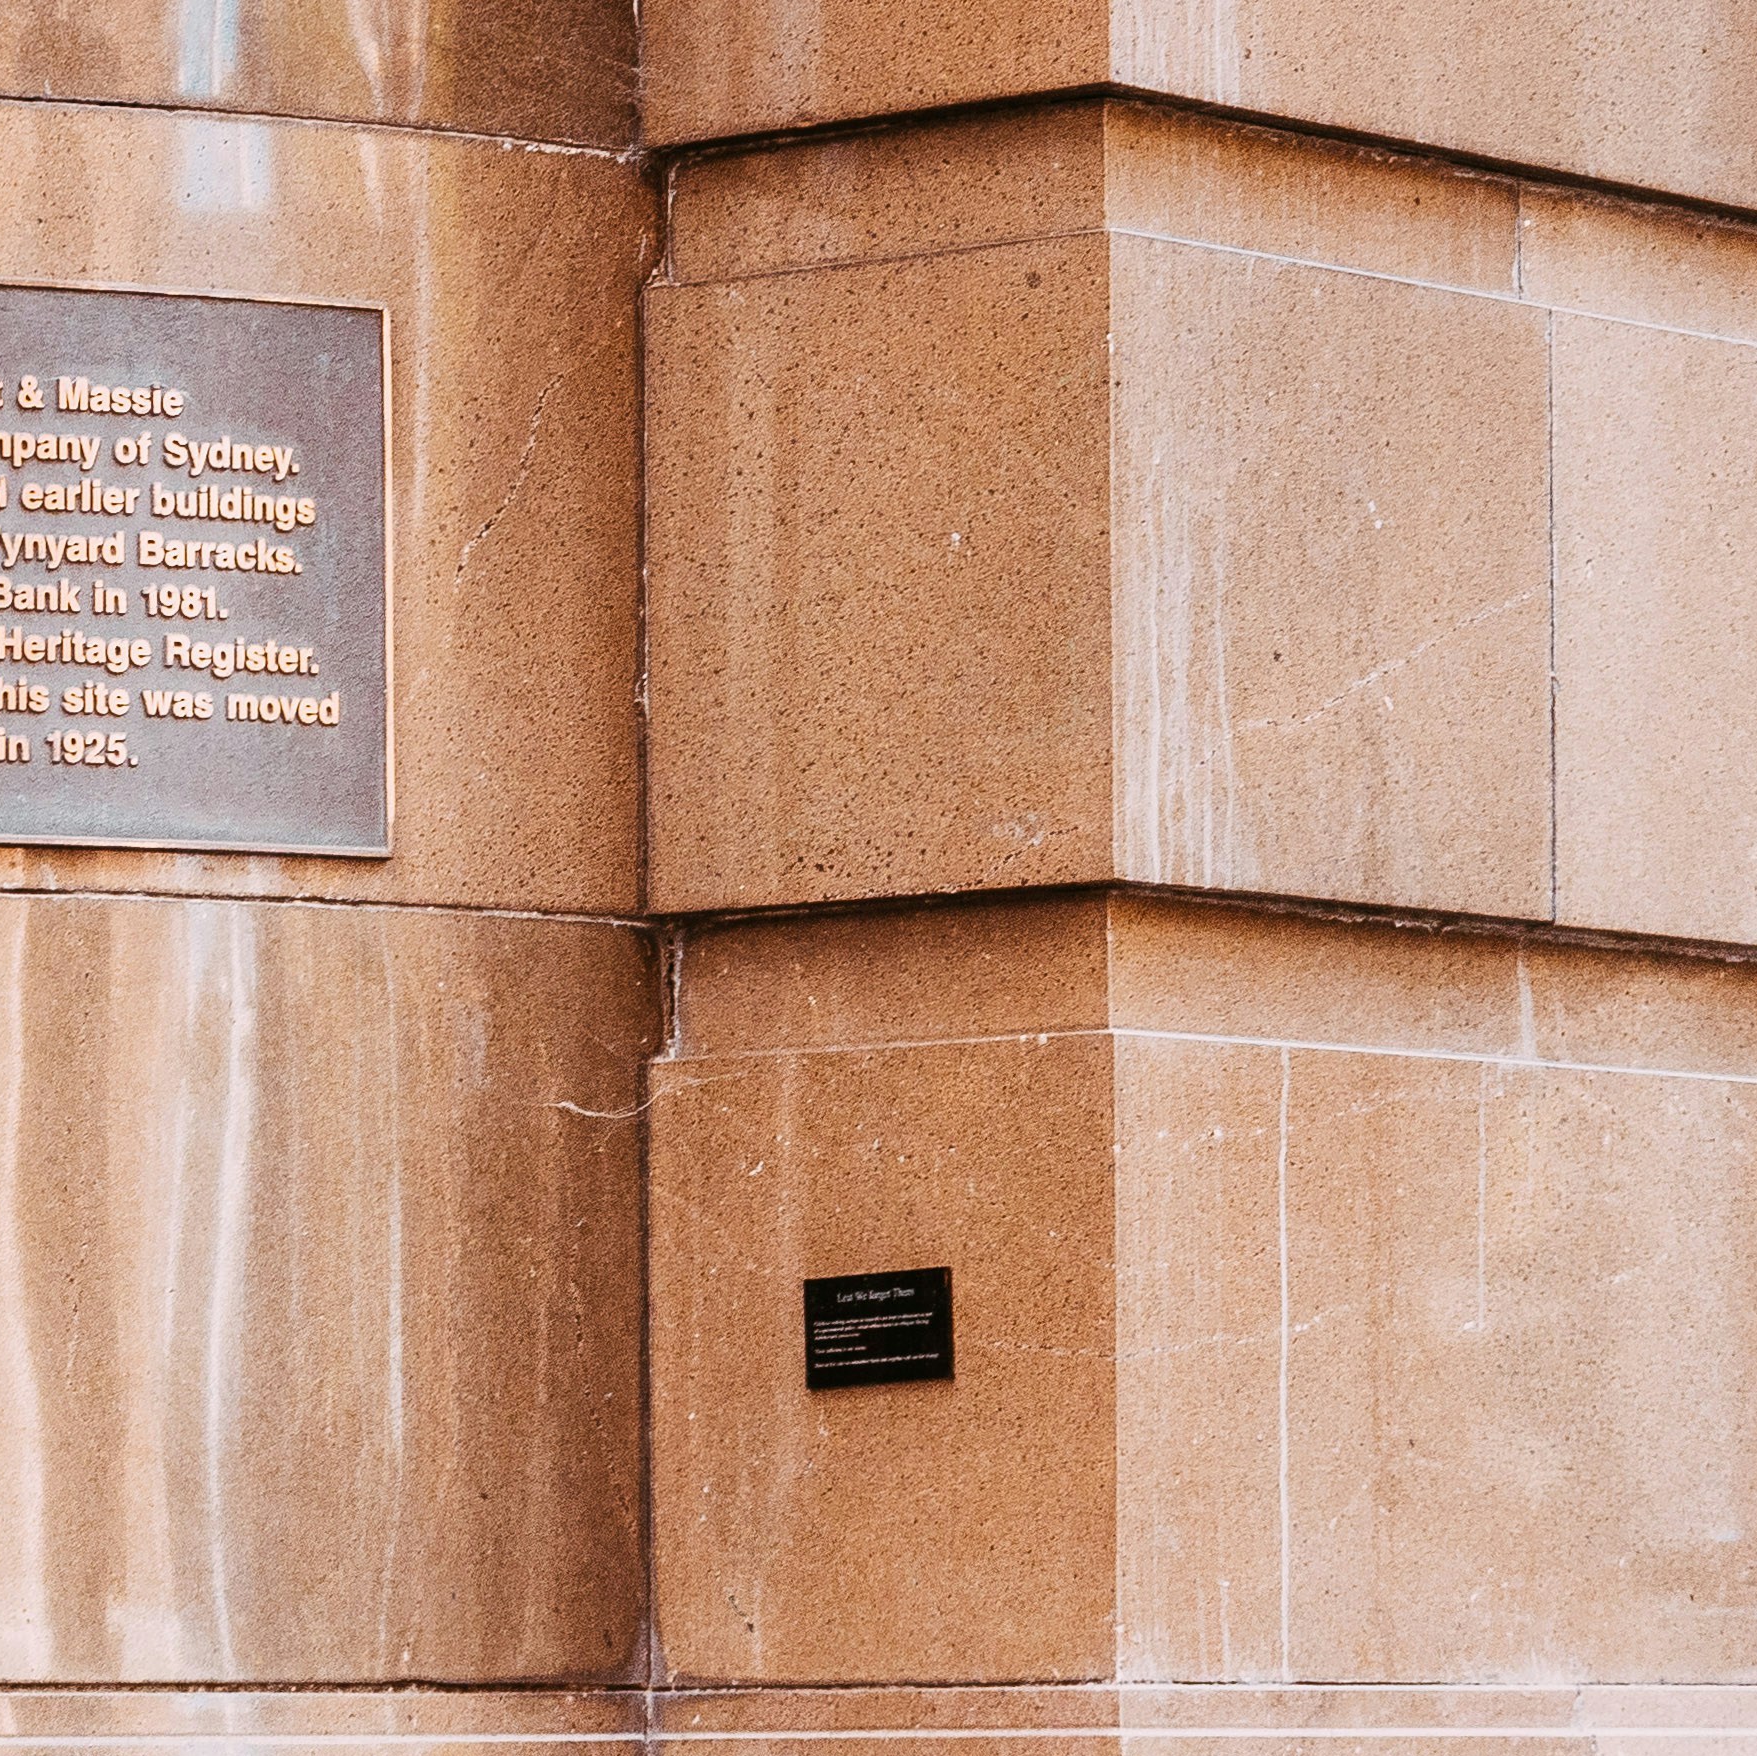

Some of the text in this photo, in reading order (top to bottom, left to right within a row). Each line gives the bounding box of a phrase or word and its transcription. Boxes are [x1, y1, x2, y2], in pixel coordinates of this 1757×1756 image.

[18, 375, 44, 409] &
[57, 377, 184, 416] Massie
[114, 433, 152, 465] of
[163, 433, 300, 480] Sydney.
[21, 479, 140, 514] earlier
[152, 484, 316, 531] buildings
[139, 531, 303, 574] Barracks.
[93, 580, 126, 614] in
[144, 584, 228, 619] 1981.
[164, 634, 320, 677] Register.
[61, 680, 130, 715] site
[143, 689, 214, 720] was
[227, 692, 340, 726] moved
[47, 730, 139, 766] 1925.
